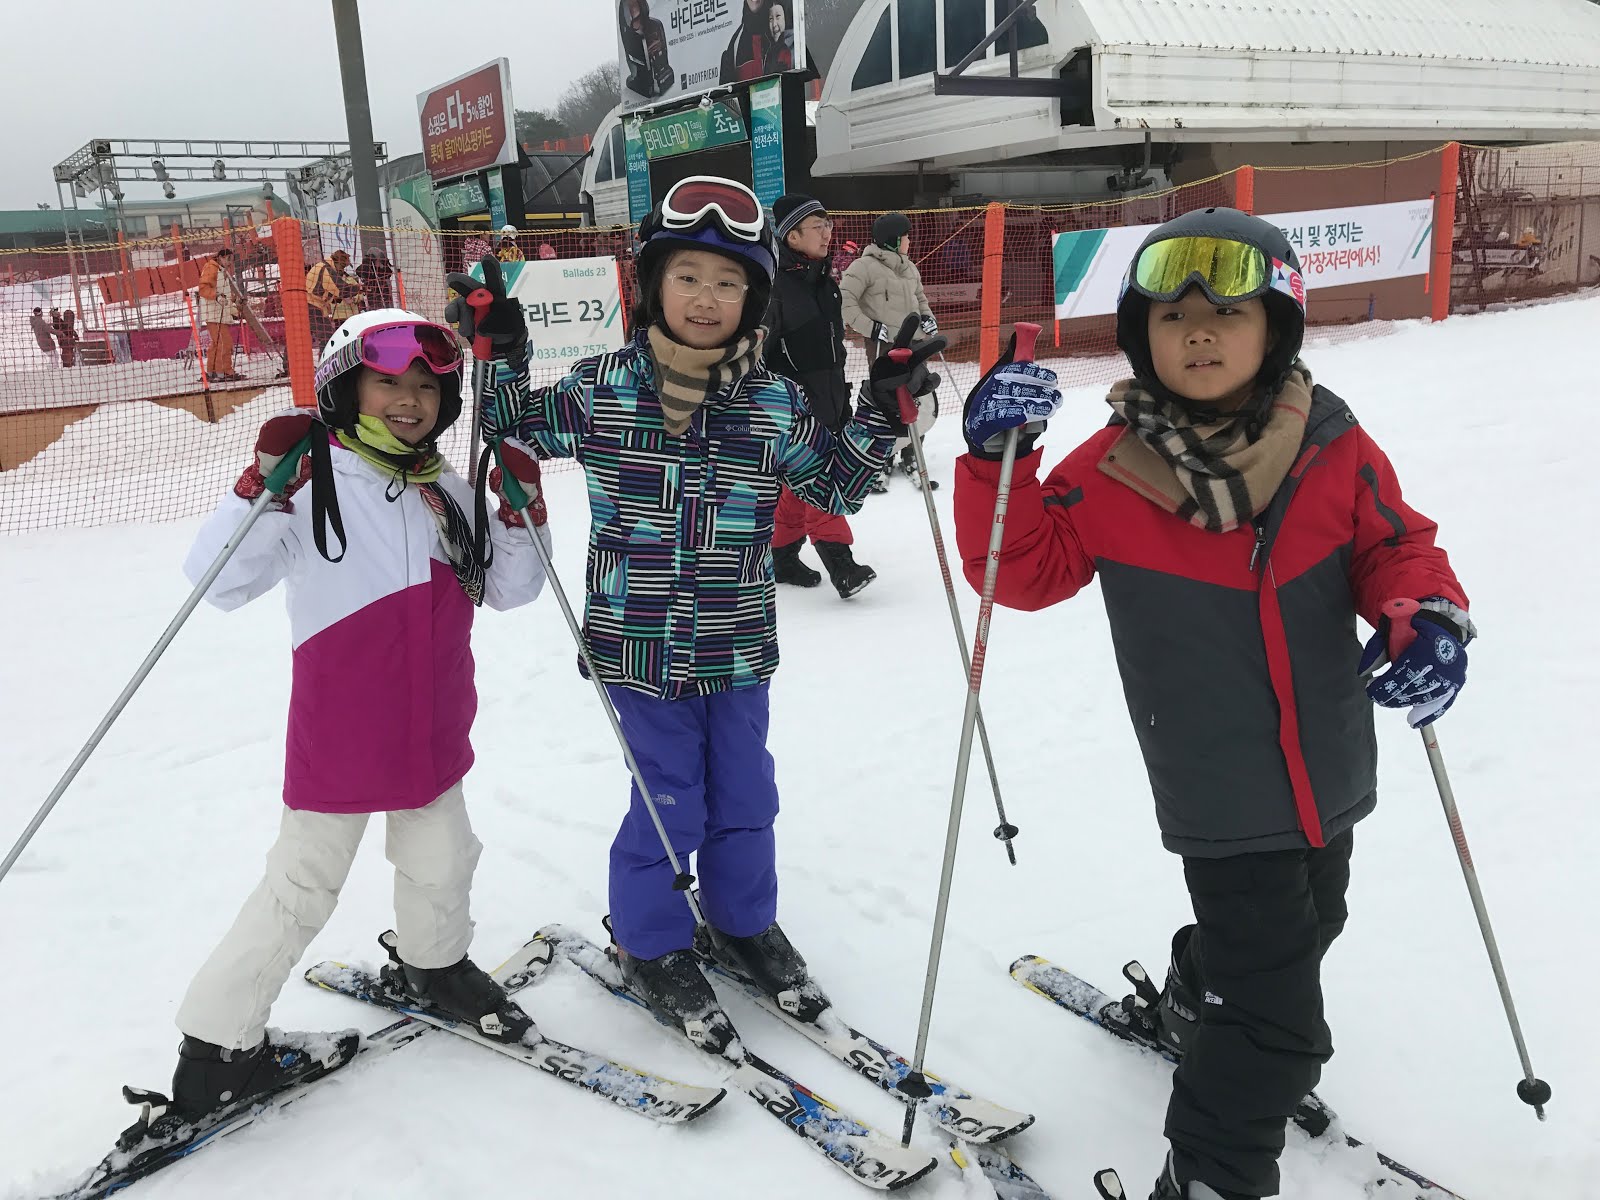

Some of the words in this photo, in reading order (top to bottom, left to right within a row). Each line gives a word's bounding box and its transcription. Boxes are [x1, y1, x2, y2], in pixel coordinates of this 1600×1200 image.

[671, 0, 728, 33] 바디프랜드
[688, 67, 719, 85] BODYFRIEND
[428, 112, 447, 136] 쇼핑은
[446, 90, 464, 130] 다
[712, 109, 740, 134] 초급
[754, 131, 778, 148] 안전수칙
[430, 141, 445, 164] 롯데
[1308, 225, 1321, 247] 및
[1325, 221, 1363, 247] 정지는
[1300, 245, 1381, 274] 가장자리에서!
[563, 268, 594, 278] Ballads
[596, 267, 607, 277] 23
[577, 300, 605, 322] 23
[537, 344, 608, 360] 033.439.7575
